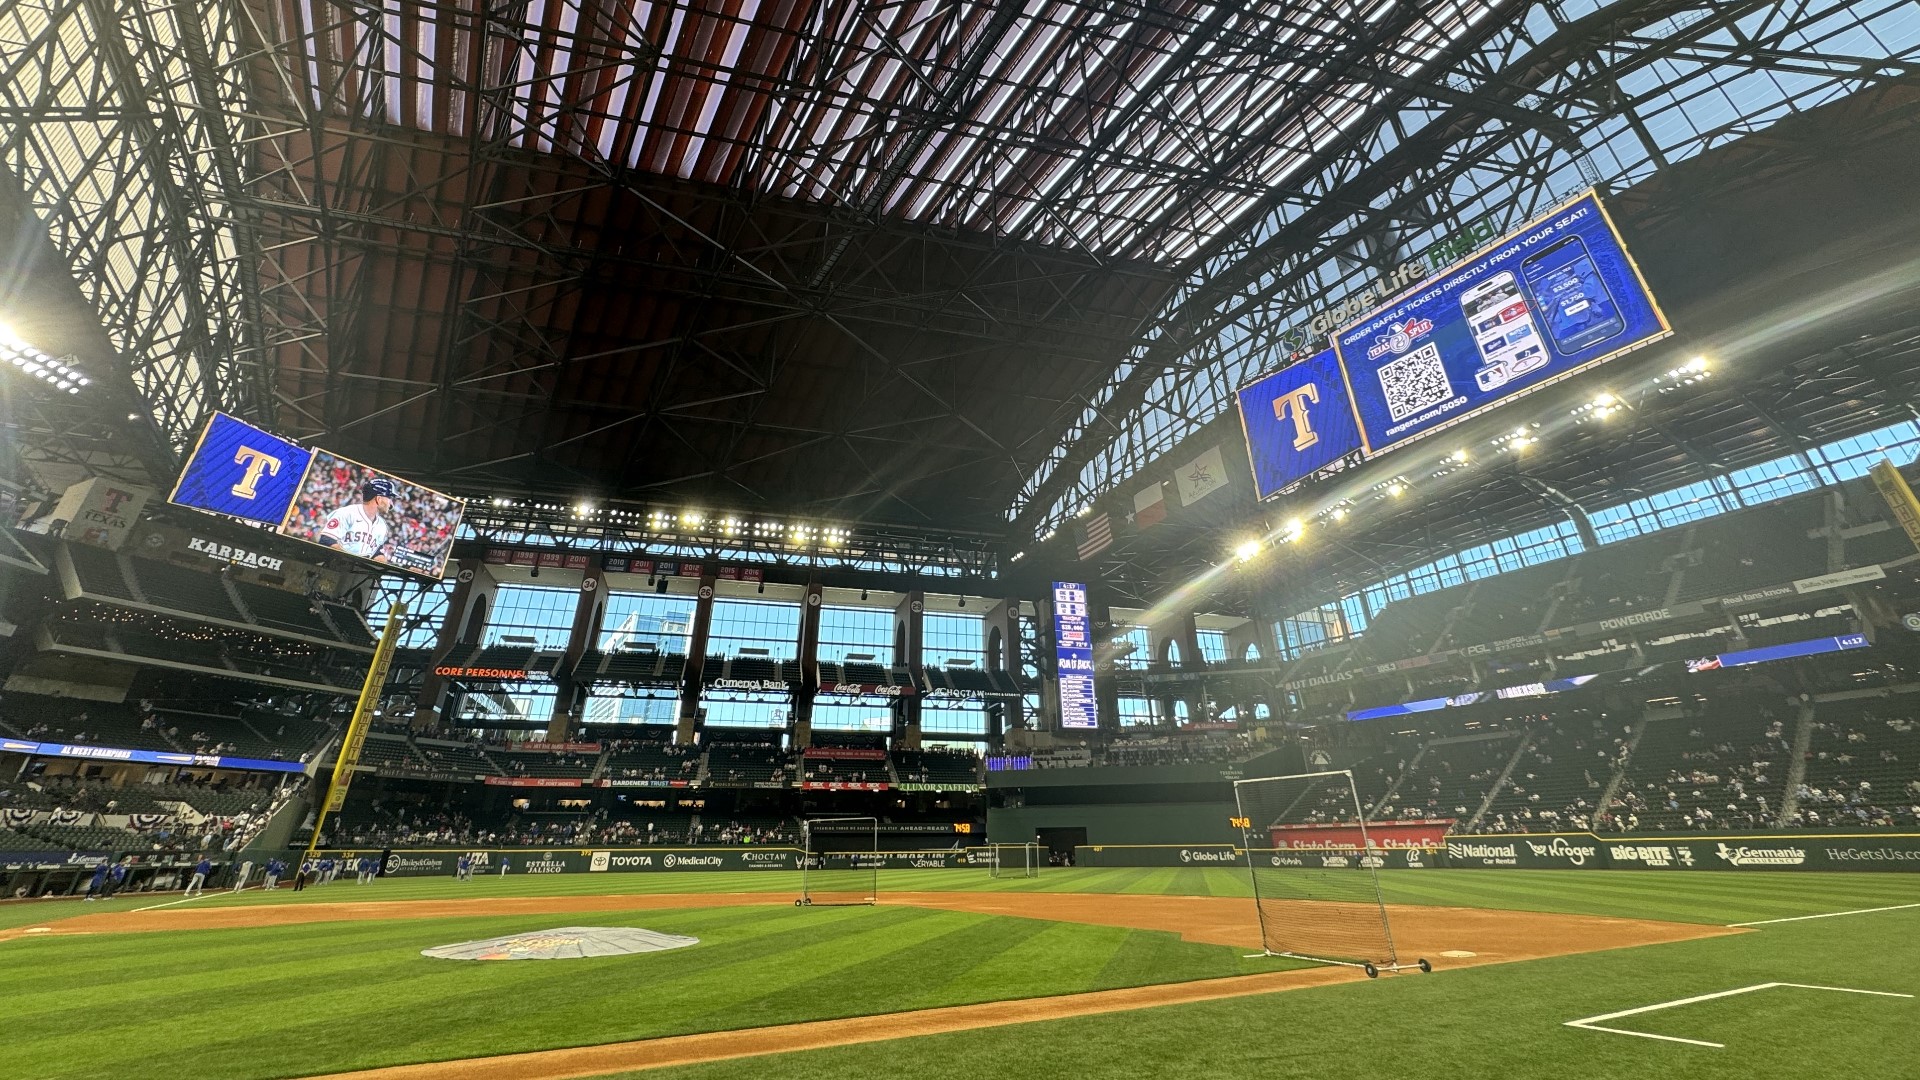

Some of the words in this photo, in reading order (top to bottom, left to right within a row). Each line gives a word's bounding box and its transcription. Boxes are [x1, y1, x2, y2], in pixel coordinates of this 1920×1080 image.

[1310, 290, 1376, 336] Globe
[1378, 261, 1427, 297] Life
[1426, 215, 1495, 269] Field
[1343, 326, 1372, 346] ORDER
[1372, 308, 1405, 331] RAFFLE
[1405, 288, 1443, 313] TICKETS
[1443, 261, 1488, 290] DIRECTLY
[1489, 245, 1521, 266] FROM
[1521, 226, 1554, 248] YOUR
[1554, 207, 1589, 230] SEAT!
[1408, 321, 1430, 338] SPLIT
[1369, 341, 1391, 359] TEXAS
[1272, 382, 1320, 453] T
[1385, 395, 1468, 437] rangers.com/5050
[234, 445, 281, 500] T
[85, 509, 127, 528] TEXAS
[187, 537, 284, 571] KARBACH
[517, 551, 534, 559] 1998
[543, 553, 560, 561] 1999
[569, 555, 587, 563] 2010
[608, 558, 625, 566] 2010
[635, 560, 650, 568] 2011
[684, 564, 700, 572] 2012
[720, 566, 736, 574] 2015
[744, 568, 759, 576] 2016
[459, 572, 472, 580] 42
[584, 580, 595, 589] 34
[700, 588, 711, 597] 26
[1722, 594, 1743, 605] Real
[1744, 591, 1762, 601] fans
[1763, 586, 1793, 598] know.
[911, 602, 922, 611] 29
[1600, 607, 1672, 631] POWERADE
[1842, 637, 1864, 646] 4:17
[1468, 643, 1491, 655] PGL
[1077, 659, 1092, 670] BACK
[1376, 663, 1397, 673] 105.3
[435, 666, 464, 676] CORE
[465, 668, 526, 679] PERSONNEL
[762, 680, 790, 690] Bank
[1292, 679, 1306, 690] UT
[1308, 670, 1354, 687] DALLAS
[939, 688, 985, 698] CHOCTAW
[1496, 685, 1535, 700] RANGERS
[61, 746, 71, 755] AL
[71, 747, 91, 756] WEST
[92, 748, 132, 759] CHAMPIONS
[906, 783, 936, 791] LUXOR
[937, 783, 978, 791] STAFFING
[746, 852, 787, 861] CHOCTAW
[1192, 851, 1218, 861] Globe
[1219, 851, 1236, 861] Life
[1548, 837, 1596, 866] Kroger
[1636, 846, 1673, 860] BITE
[1739, 846, 1804, 858] Germania
[386, 859, 399, 868] BG
[525, 860, 566, 868] ESTRELLA
[611, 856, 652, 866] TOYOTA
